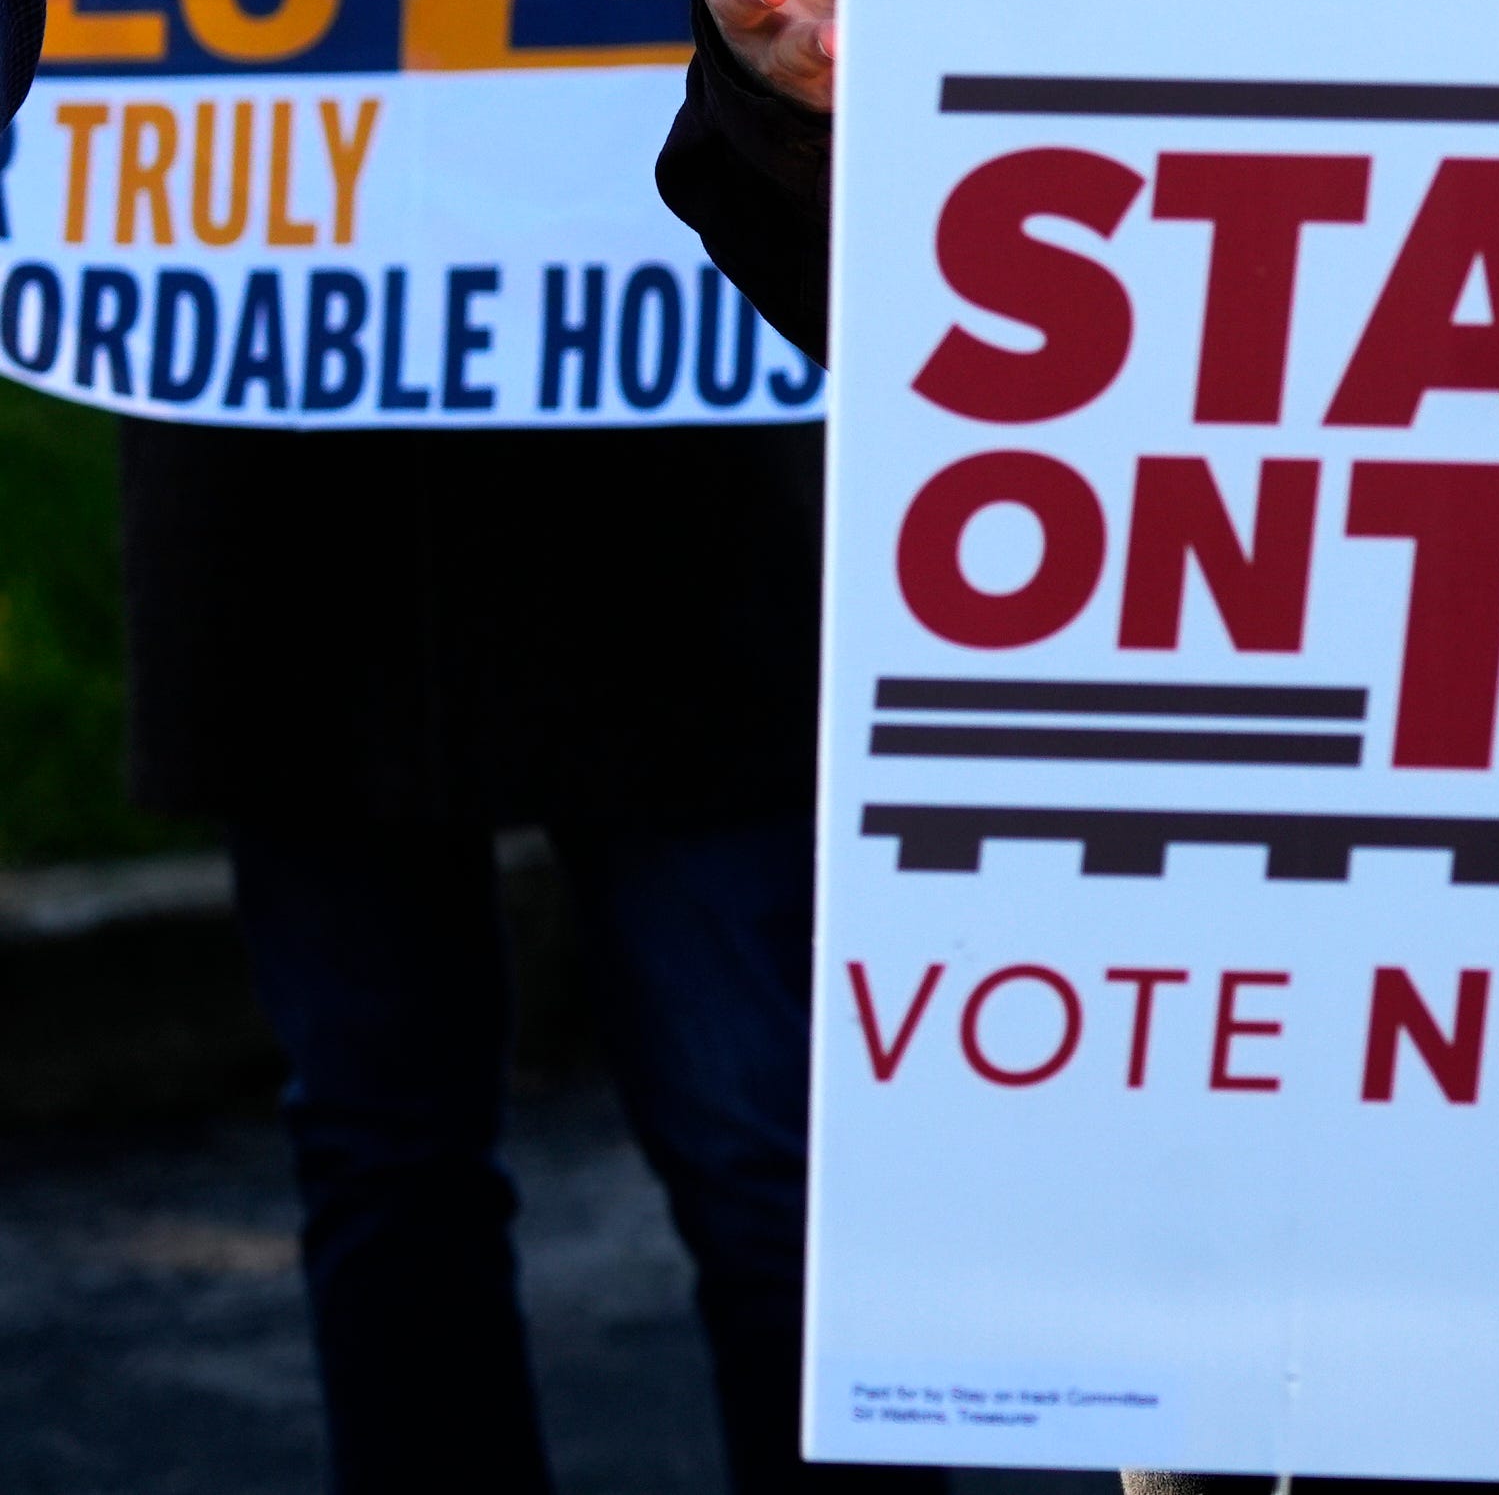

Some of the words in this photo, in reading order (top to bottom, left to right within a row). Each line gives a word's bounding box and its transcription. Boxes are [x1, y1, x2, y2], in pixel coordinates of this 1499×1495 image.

[56, 99, 380, 247] TRULY
[0, 263, 500, 411] ORDABLE
[896, 448, 1323, 655] ON
[847, 961, 1291, 1093] VOTE
[853, 1383, 890, 1401] Paid
[896, 1385, 918, 1402] for
[923, 1386, 944, 1406] by
[951, 1385, 986, 1405] Stay
[1066, 1387, 1160, 1406] Committee
[957, 1408, 1039, 1425] Treasurer
